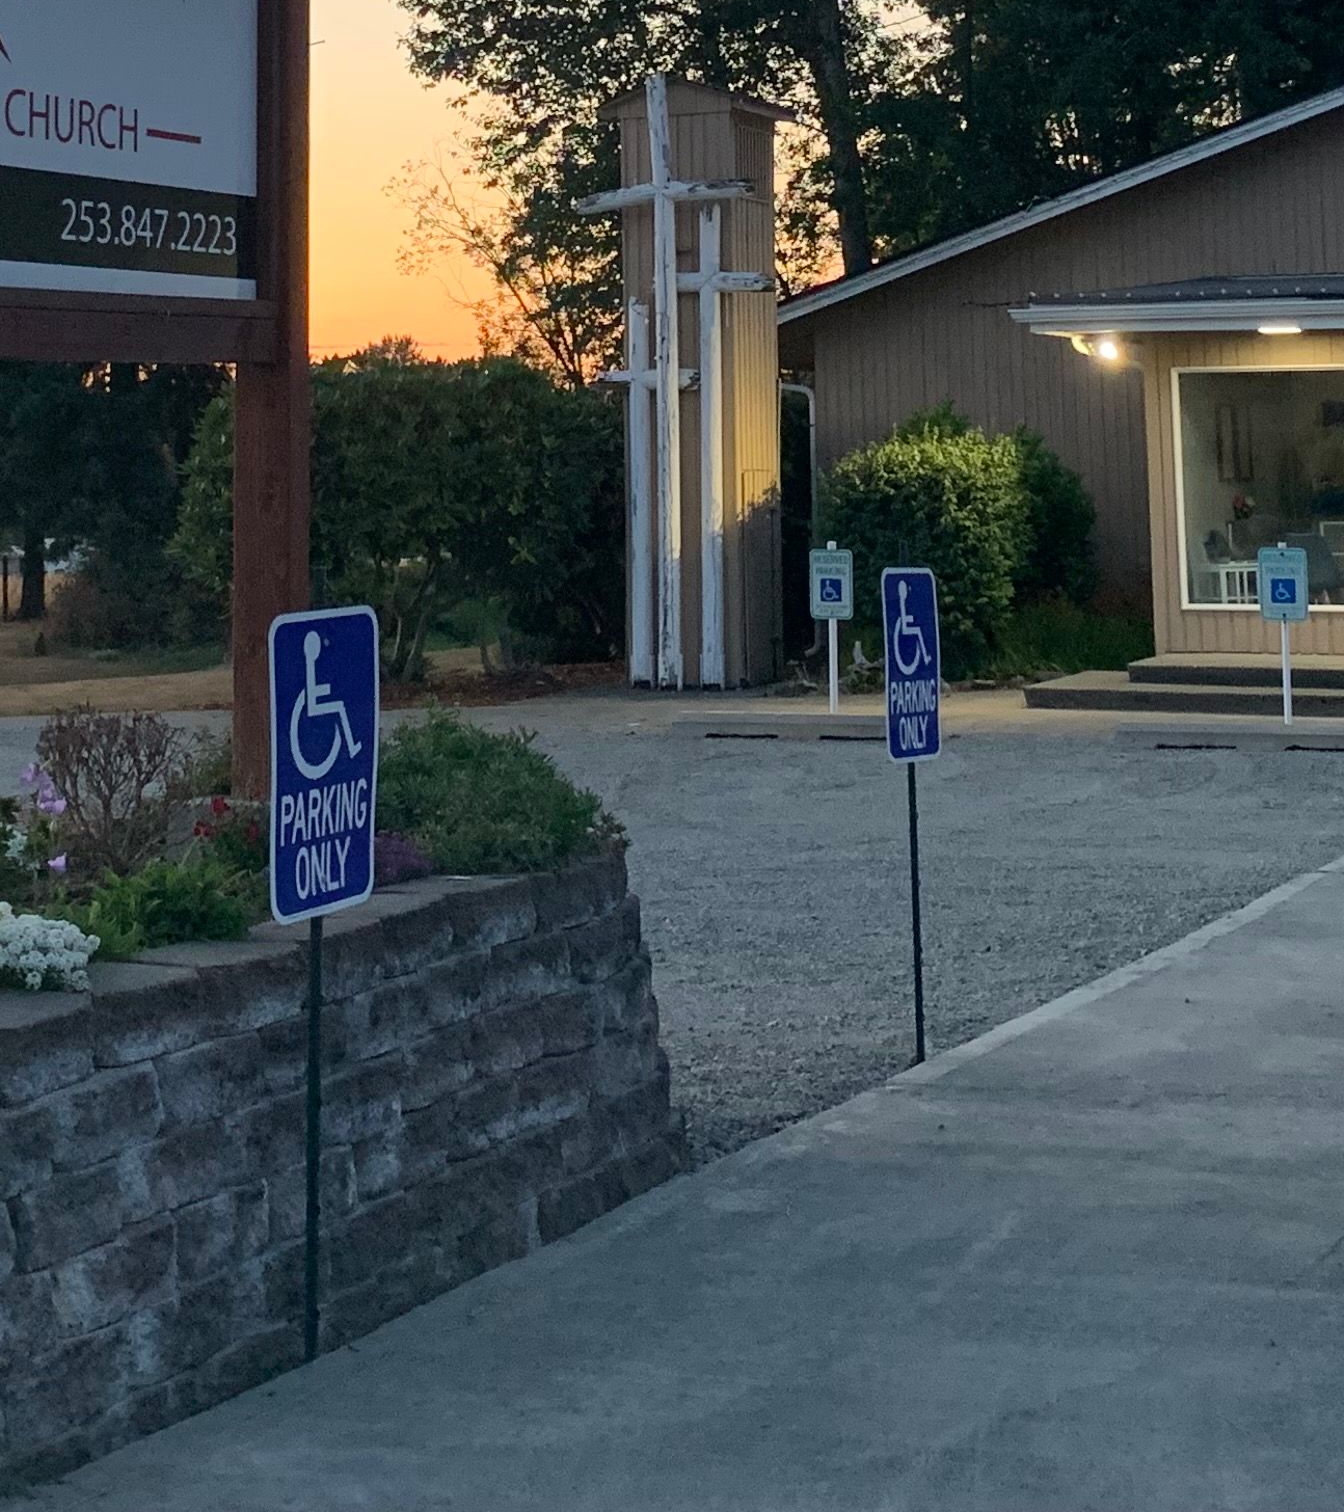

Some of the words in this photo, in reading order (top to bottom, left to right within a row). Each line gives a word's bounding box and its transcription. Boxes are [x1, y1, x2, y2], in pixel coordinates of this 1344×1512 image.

[4, 89, 140, 152] CHURCH
[60, 198, 238, 257] 253.847.2223
[890, 678, 936, 714] PARKING
[898, 715, 928, 750] ONLY
[280, 778, 367, 847] PARKING
[295, 836, 351, 900] ONLY
